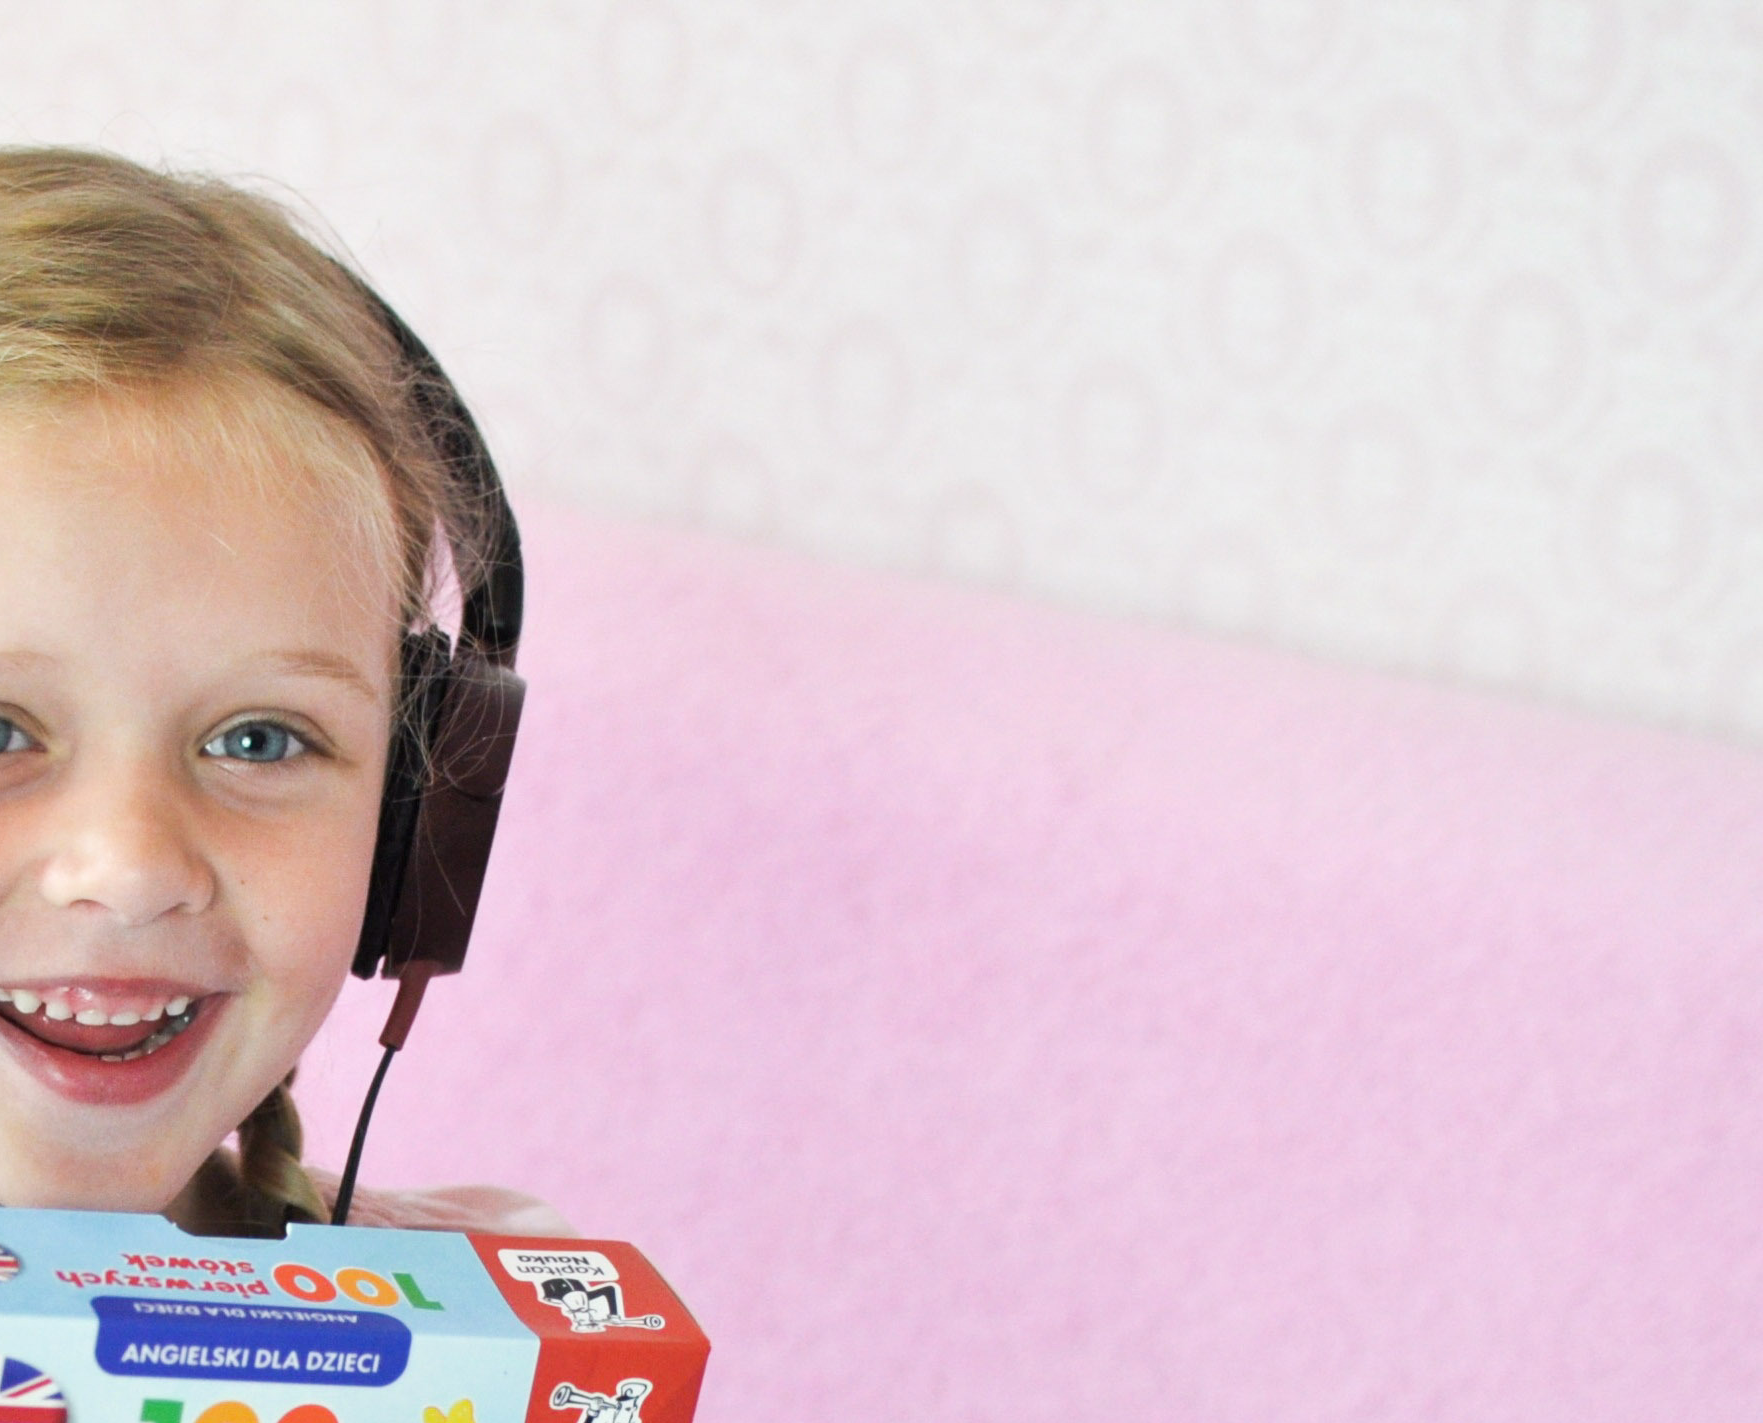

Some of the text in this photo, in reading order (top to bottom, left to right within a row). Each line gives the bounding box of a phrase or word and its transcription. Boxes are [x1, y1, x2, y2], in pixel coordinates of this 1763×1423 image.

[121, 1253, 254, 1276] słówek
[517, 1255, 590, 1266] Nauka
[517, 1265, 605, 1276] Kapitan
[55, 1263, 445, 1311] 100 pierwszych
[133, 1303, 358, 1323] ANGIELSKI DLA DZIECI
[121, 1343, 380, 1374] ANGIELSKI DLA DZIECI
